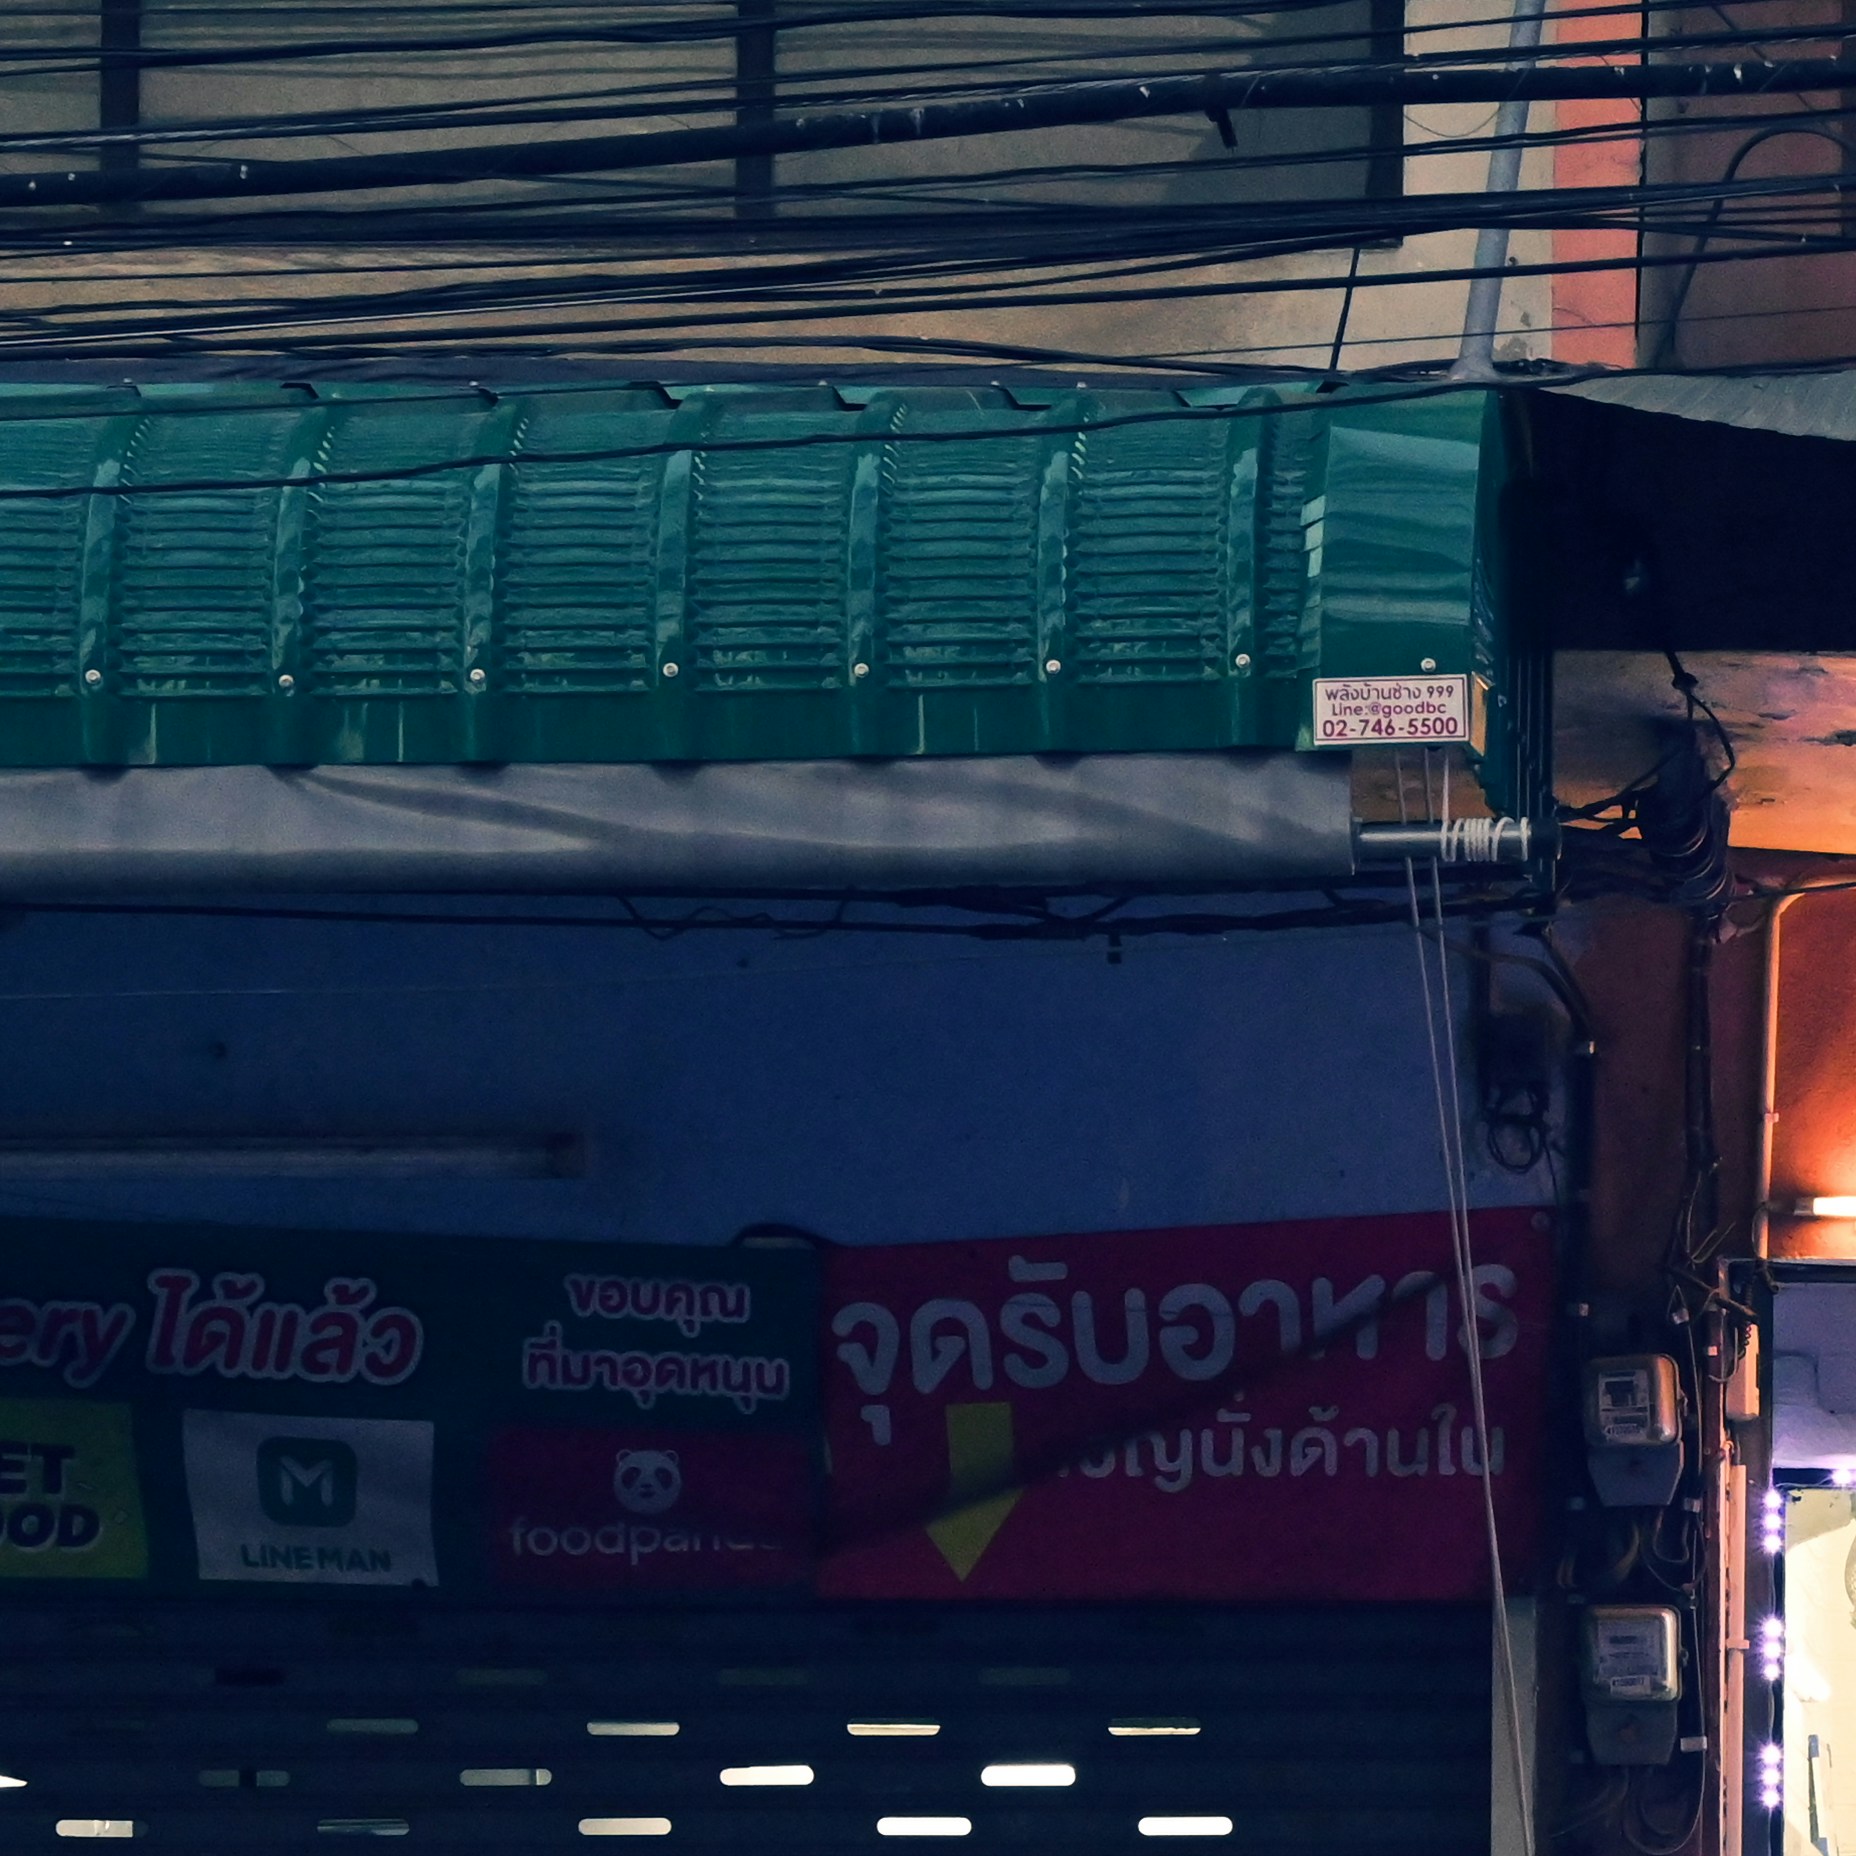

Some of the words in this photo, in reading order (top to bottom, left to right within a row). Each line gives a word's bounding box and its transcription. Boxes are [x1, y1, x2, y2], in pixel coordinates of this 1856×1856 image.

[1325, 682, 1421, 701] พลังบ้านช่าง
[1427, 686, 1454, 699] 999
[1332, 702, 1446, 718] Line:@goodbc
[1323, 717, 1458, 738] 02-746-5500
[146, 1267, 424, 1386] ได้แล้ว
[563, 1273, 751, 1338] ขอบคุณ
[522, 1319, 790, 1414] ที่มาอุดหนุน
[831, 1254, 1520, 1446] จุดรับอาหาร
[0, 1504, 100, 1547] OD
[510, 1515, 784, 1565] foodpan
[241, 1543, 312, 1570] LINE
[317, 1549, 391, 1572] MAN
